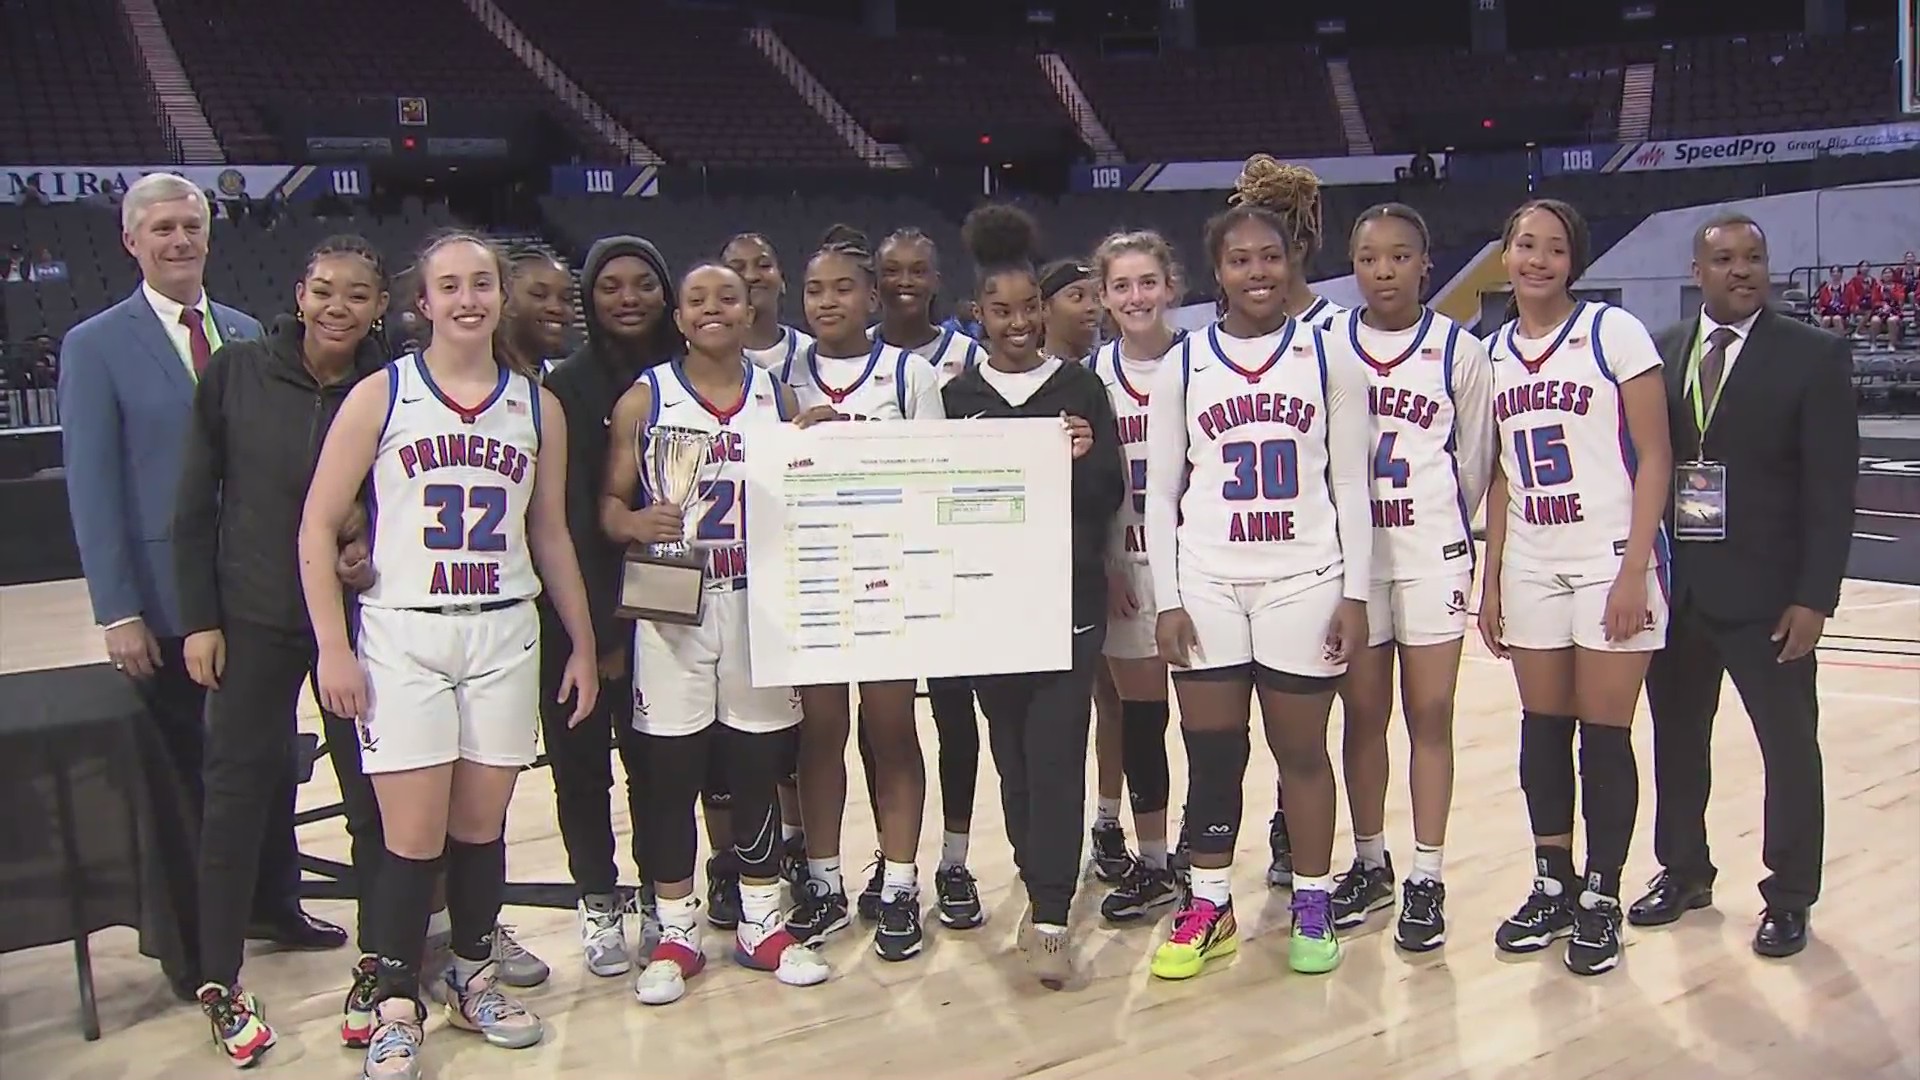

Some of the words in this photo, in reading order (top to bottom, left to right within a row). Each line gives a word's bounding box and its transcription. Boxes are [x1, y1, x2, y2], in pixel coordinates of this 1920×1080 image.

[1562, 150, 1593, 171] 108
[1674, 138, 1776, 163] SpeedPro
[1787, 138, 1821, 151] Great
[332, 170, 361, 194] 111
[586, 170, 613, 192] 110
[1092, 168, 1121, 188] 109
[1197, 393, 1316, 441] PRINCESS
[1367, 386, 1440, 430] NCESS
[1493, 380, 1594, 422] RINCESS
[398, 433, 528, 484] PRINCESS
[1222, 439, 1299, 500] 30
[1367, 431, 1410, 488] 4
[1513, 423, 1574, 489] 15
[424, 484, 507, 551] 32
[1229, 511, 1296, 542] ANNE
[1371, 498, 1415, 528] NNE
[1524, 493, 1585, 526] ANNE
[429, 561, 500, 595] ANNE
